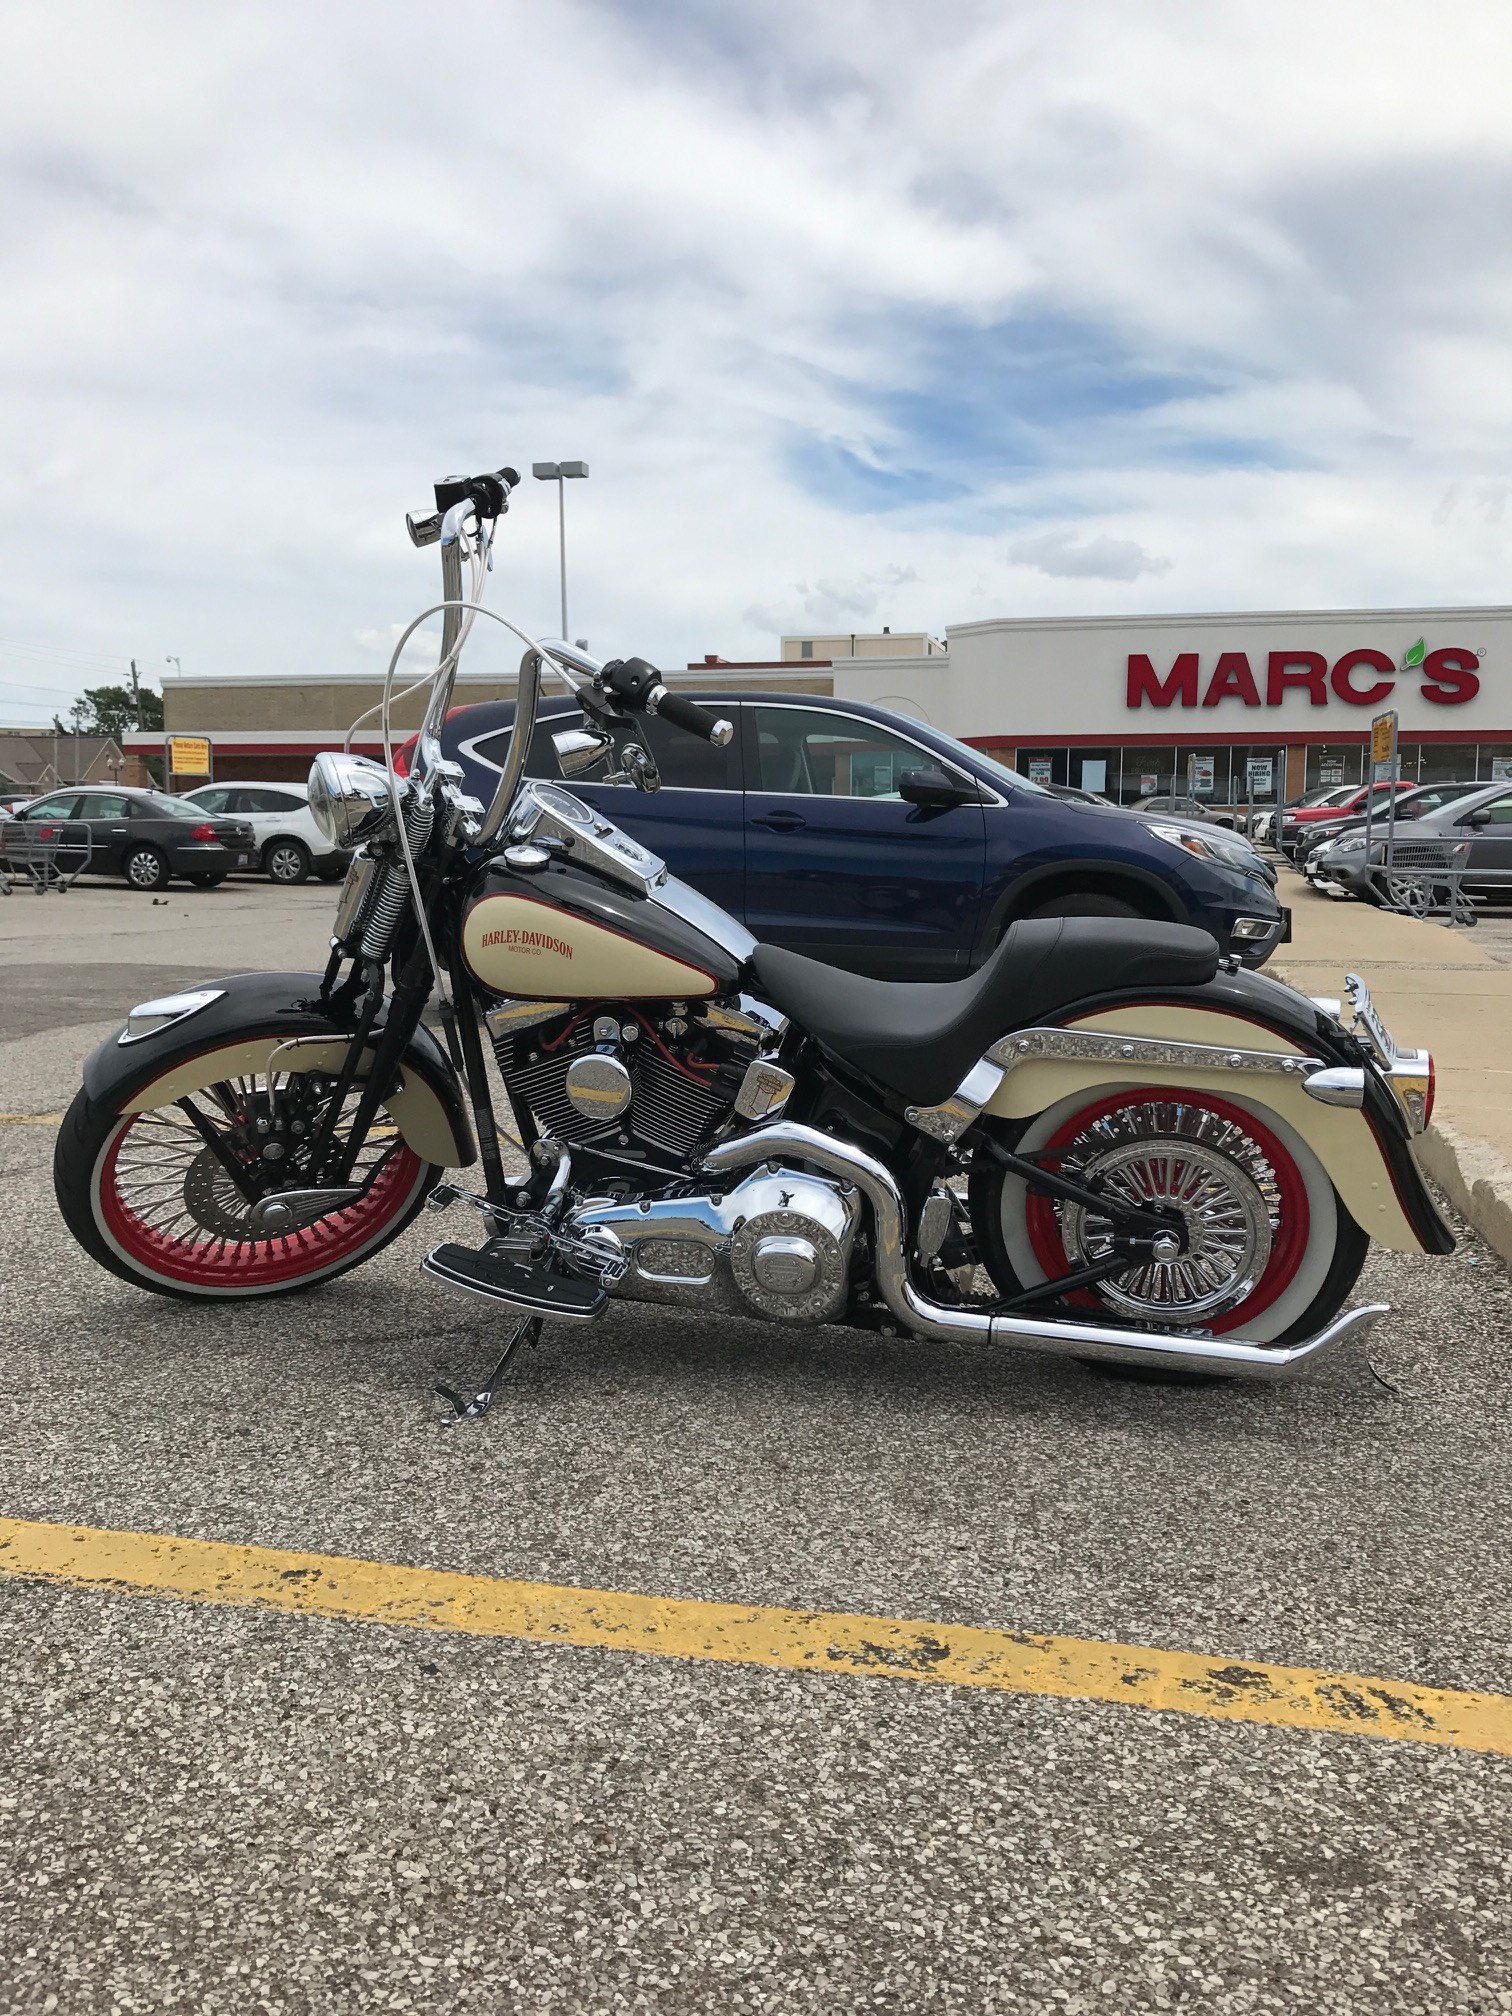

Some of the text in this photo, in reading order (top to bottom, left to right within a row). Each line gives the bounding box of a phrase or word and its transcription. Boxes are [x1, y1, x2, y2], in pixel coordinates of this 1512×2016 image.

[1127, 643, 1480, 707] MARC'S
[482, 929, 573, 960] HARLEY-DAVIDSON
[508, 945, 531, 955] MOTOR
